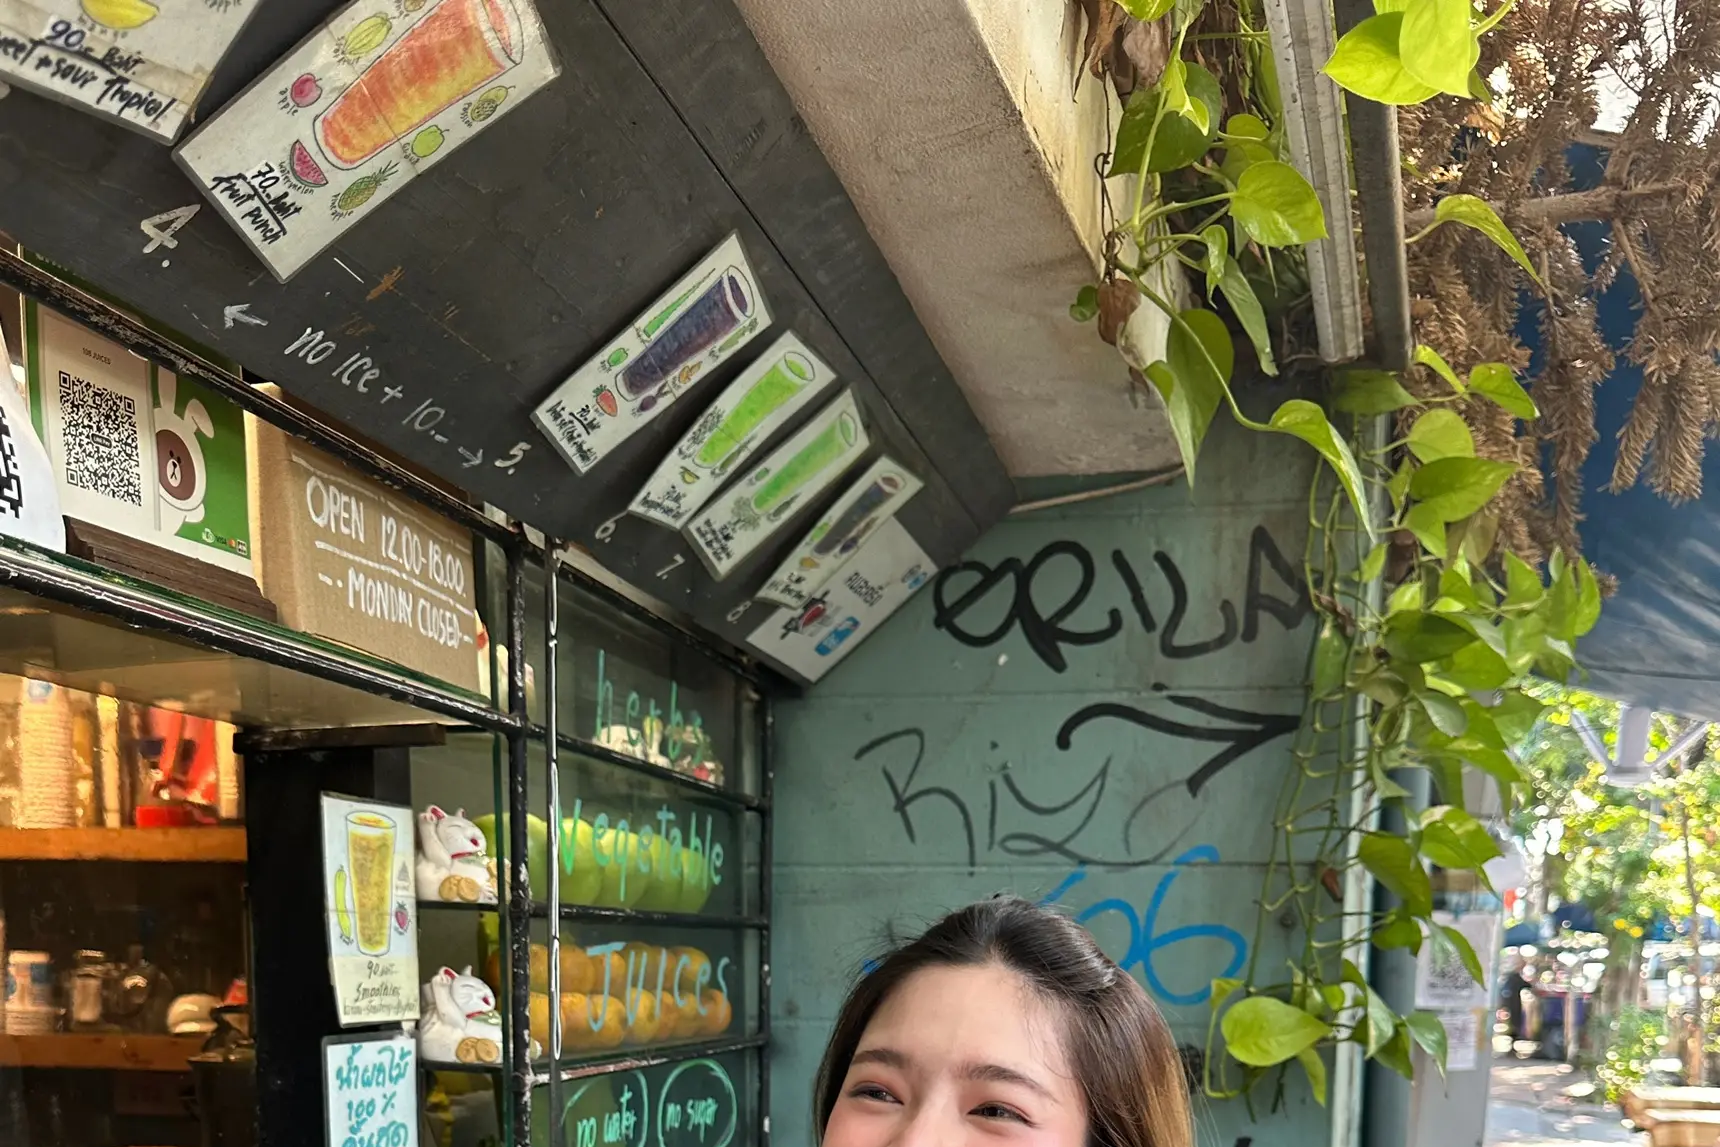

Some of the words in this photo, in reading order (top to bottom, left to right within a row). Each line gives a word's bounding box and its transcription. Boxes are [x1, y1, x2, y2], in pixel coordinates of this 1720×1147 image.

[278, 87, 299, 116] apple
[278, 161, 315, 196] watermelon
[380, 384, 404, 405] +
[306, 475, 365, 544] OPEN
[348, 566, 413, 628] MONDAY
[666, 1102, 682, 1132] no
